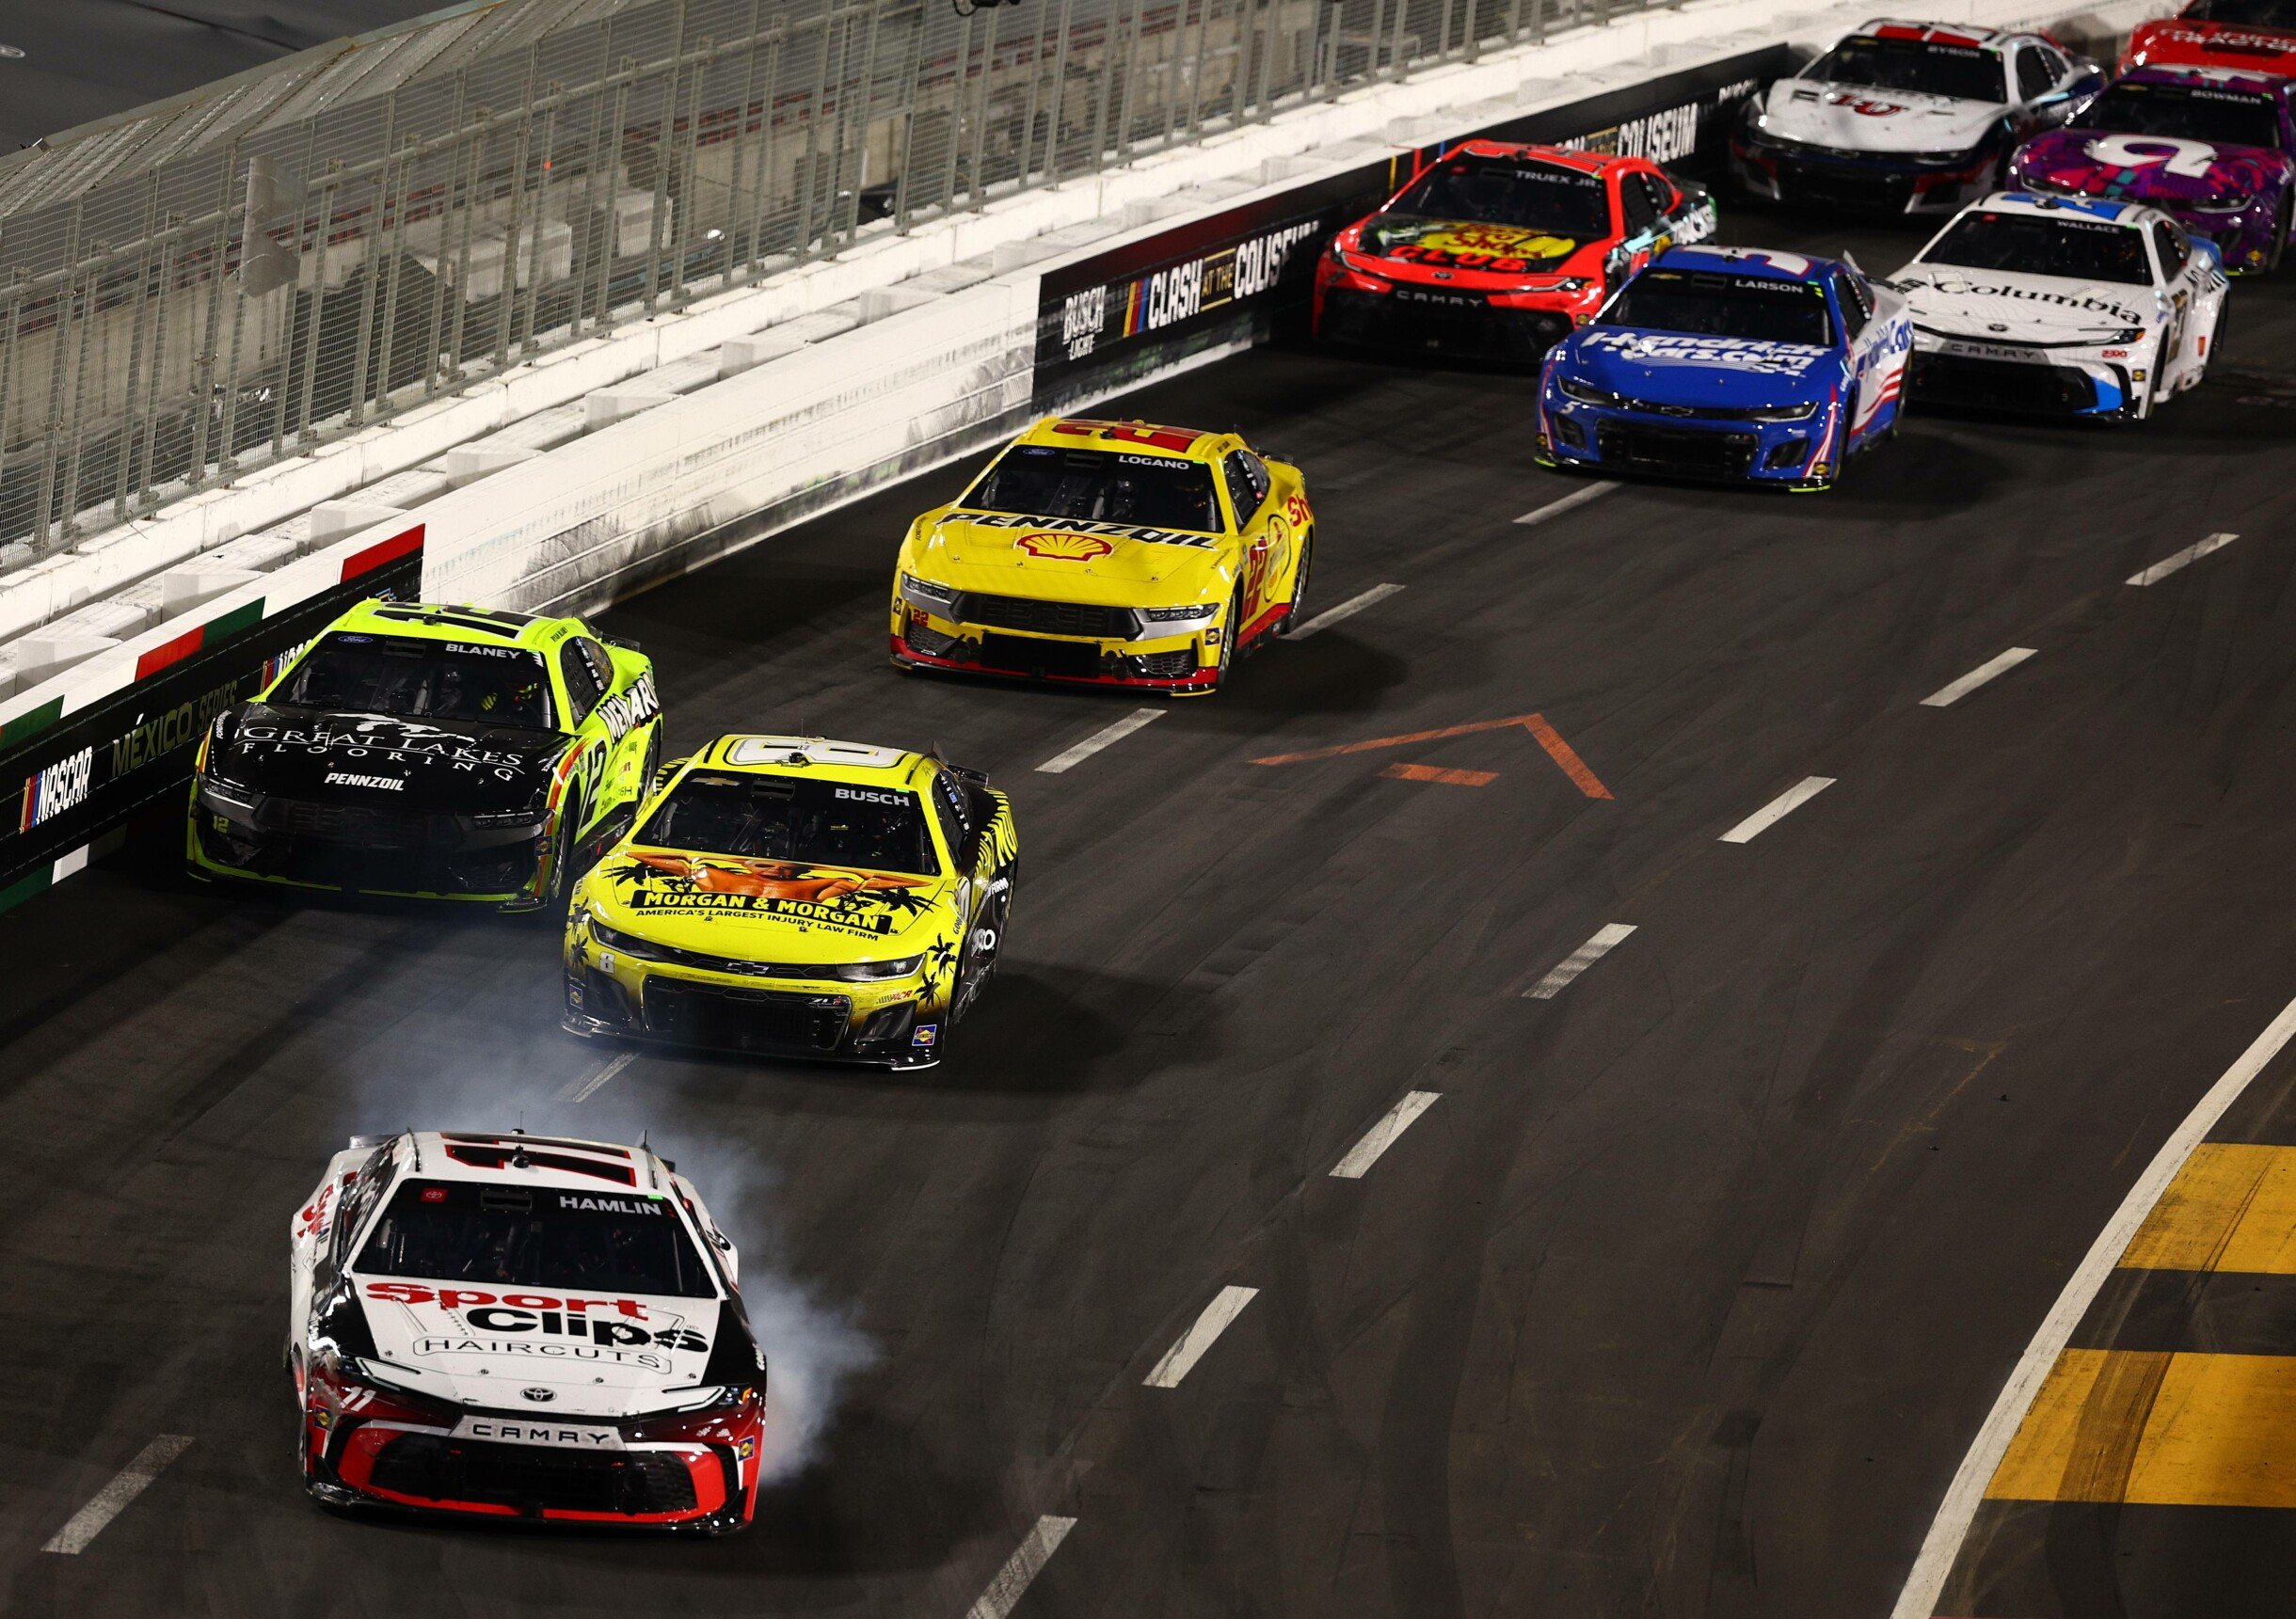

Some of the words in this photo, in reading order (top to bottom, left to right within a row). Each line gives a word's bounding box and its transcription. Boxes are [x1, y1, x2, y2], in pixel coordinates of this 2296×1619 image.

[2190, 89, 2261, 104] BOWMAN
[1515, 169, 1571, 183] TRUEX
[2056, 220, 2120, 234] WALLACE
[1147, 258, 1204, 329] CLASH
[1201, 269, 1215, 297] AT
[1215, 262, 1235, 292] THE
[1734, 278, 1804, 294] LARSON
[1396, 290, 1483, 308] CAMRY
[1933, 280, 2143, 325] Columbia
[1062, 285, 1108, 345] BUSCH
[1951, 342, 2036, 359] CAMRY
[1118, 454, 1190, 470] LOGANO
[934, 513, 1220, 550] PENNZOIL
[913, 608, 930, 627] 22
[445, 643, 521, 659] BLANEY
[244, 726, 386, 747] GREAT
[400, 737, 524, 766] LAKES
[35, 746, 93, 825] NASCAR
[111, 702, 193, 778] MÉXICO
[242, 742, 514, 782] FLOORING
[324, 772, 405, 791] PENNZOIL
[834, 787, 911, 807] BUSCH
[213, 814, 230, 833] 12
[644, 891, 746, 909] MORGAN
[755, 897, 770, 911] &
[776, 898, 880, 930] MORGAN
[635, 909, 706, 917] AMERICA'S
[708, 910, 765, 920] LARGEST
[766, 914, 814, 928] INJURY
[816, 923, 846, 933] LAW
[847, 928, 880, 942] FIRM
[599, 951, 615, 975] 8
[559, 1195, 662, 1216] HAMLIN
[365, 1282, 649, 1321] Sport
[466, 1308, 710, 1353] Clips
[424, 1339, 661, 1369] HAIRCUTS
[339, 1386, 376, 1412] 11
[471, 1423, 611, 1445] CAMRY
